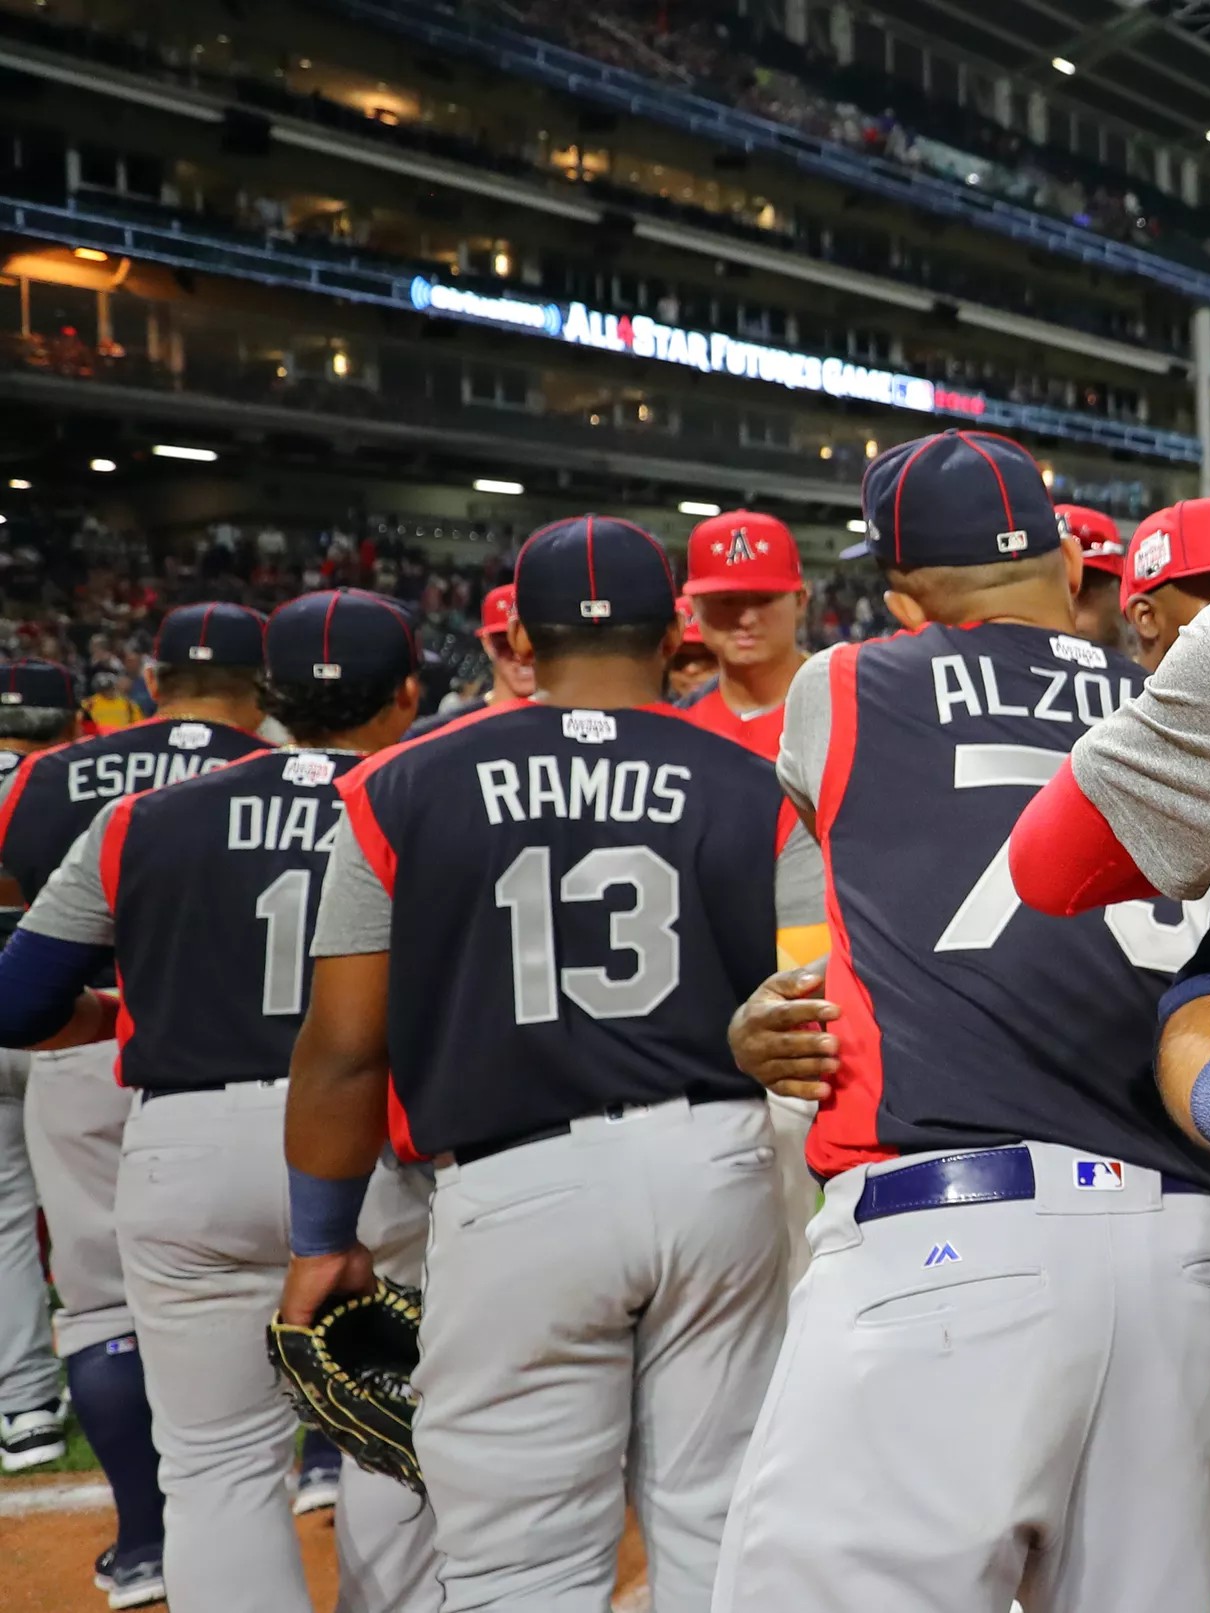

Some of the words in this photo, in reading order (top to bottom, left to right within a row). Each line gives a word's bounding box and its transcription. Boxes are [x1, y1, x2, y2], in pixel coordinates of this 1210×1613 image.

[726, 526, 757, 566] A
[476, 754, 692, 825] RAMOS
[228, 795, 345, 853] DIAZ
[495, 845, 680, 1025] 13
